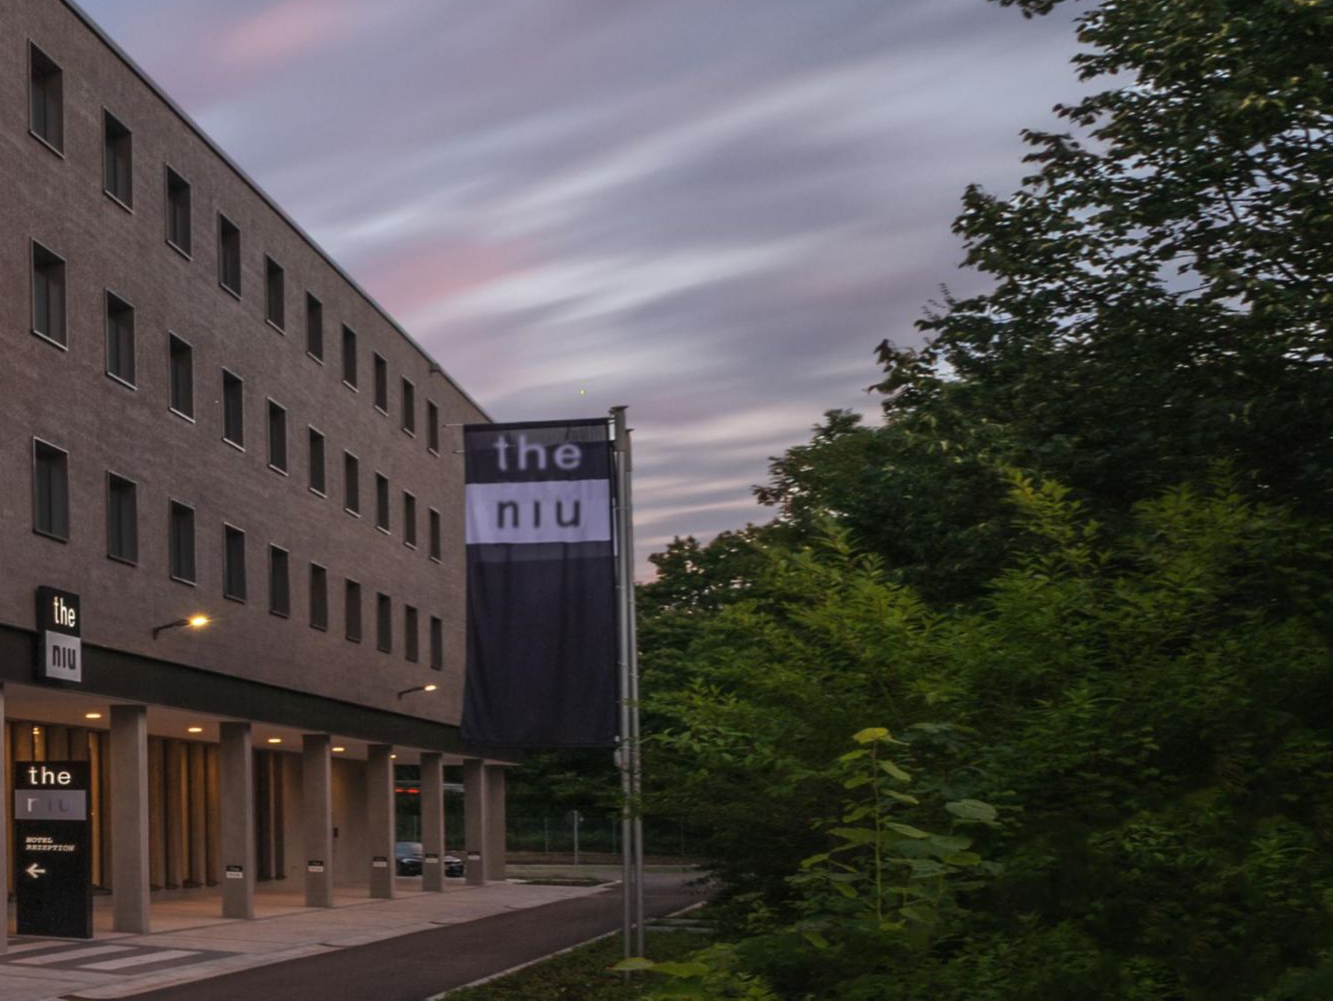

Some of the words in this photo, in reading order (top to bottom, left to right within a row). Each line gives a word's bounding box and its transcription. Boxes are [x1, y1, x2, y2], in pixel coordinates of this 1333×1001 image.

[494, 434, 582, 471] the
[497, 499, 581, 529] niu
[53, 596, 76, 628] the
[52, 644, 76, 670] niu
[28, 765, 71, 785] the
[25, 836, 53, 844] HOTEL
